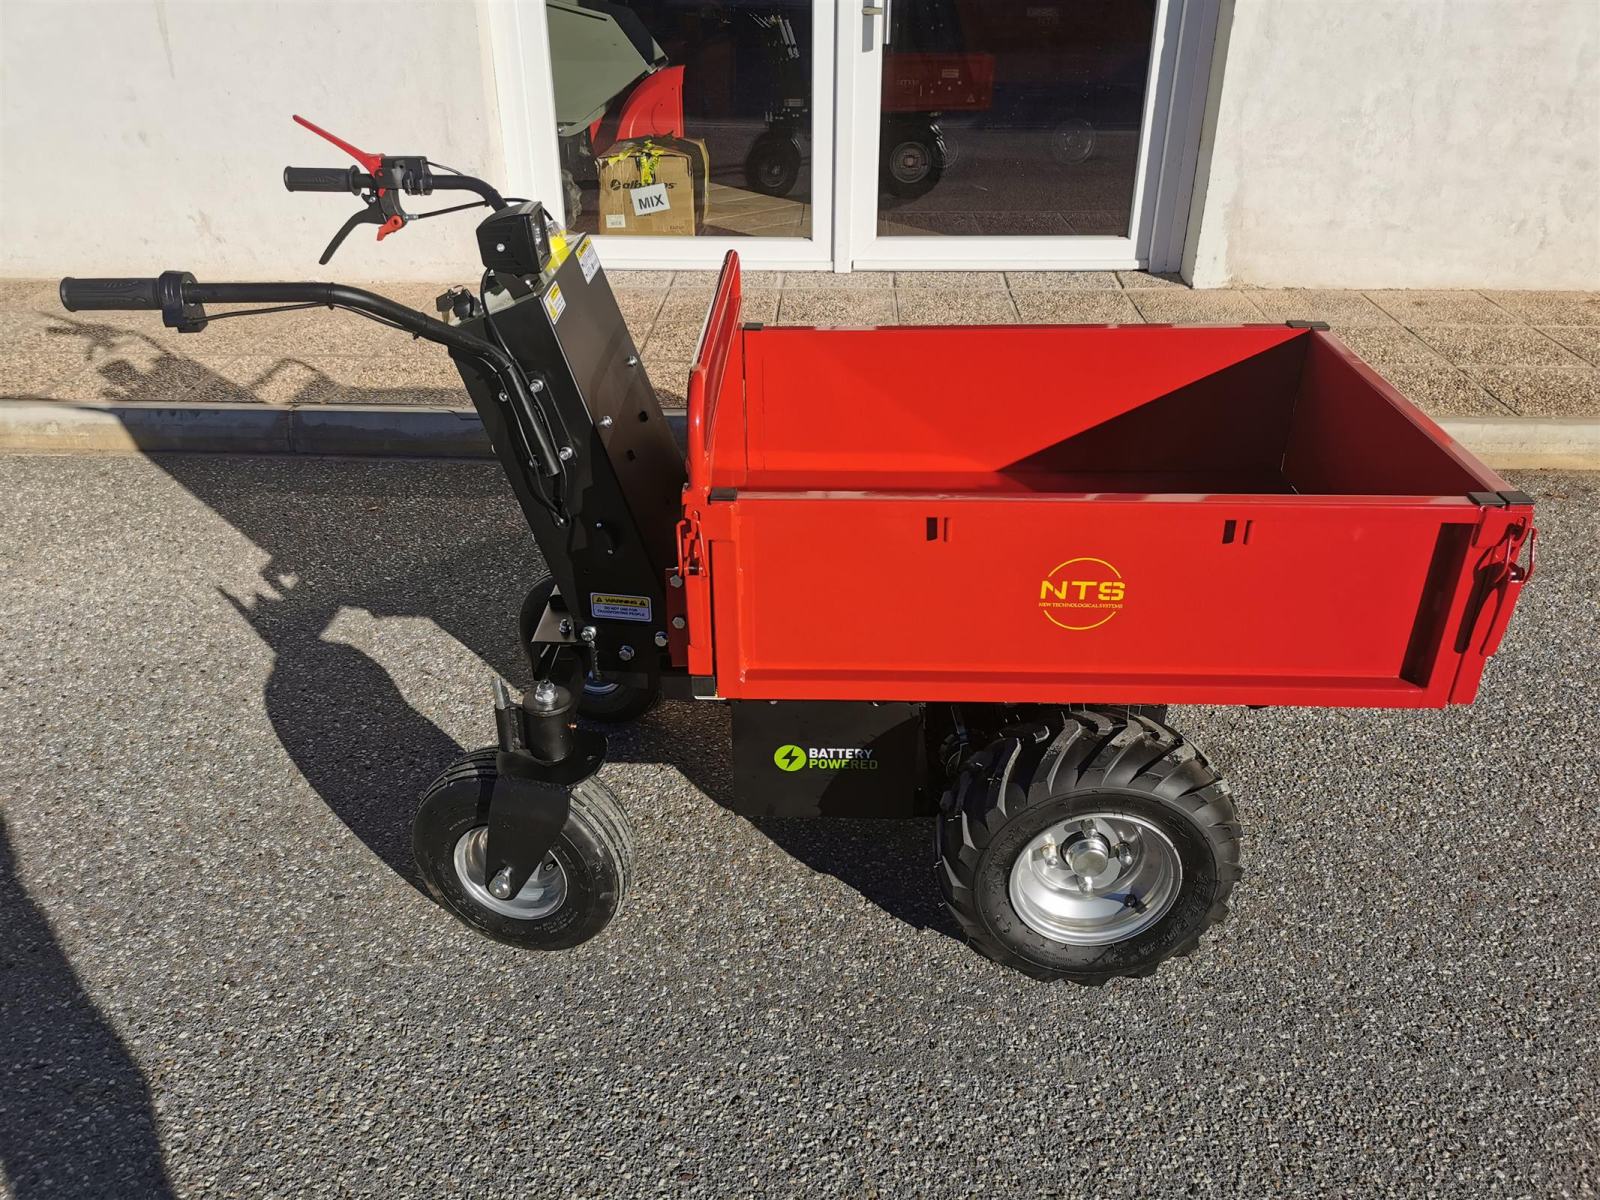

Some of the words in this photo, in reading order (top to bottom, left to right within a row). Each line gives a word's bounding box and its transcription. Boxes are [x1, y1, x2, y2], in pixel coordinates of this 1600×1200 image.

[638, 194, 665, 210] MIX
[1040, 580, 1126, 601] NTS
[809, 748, 873, 759] BATTERY
[809, 759, 878, 770] POWERED
